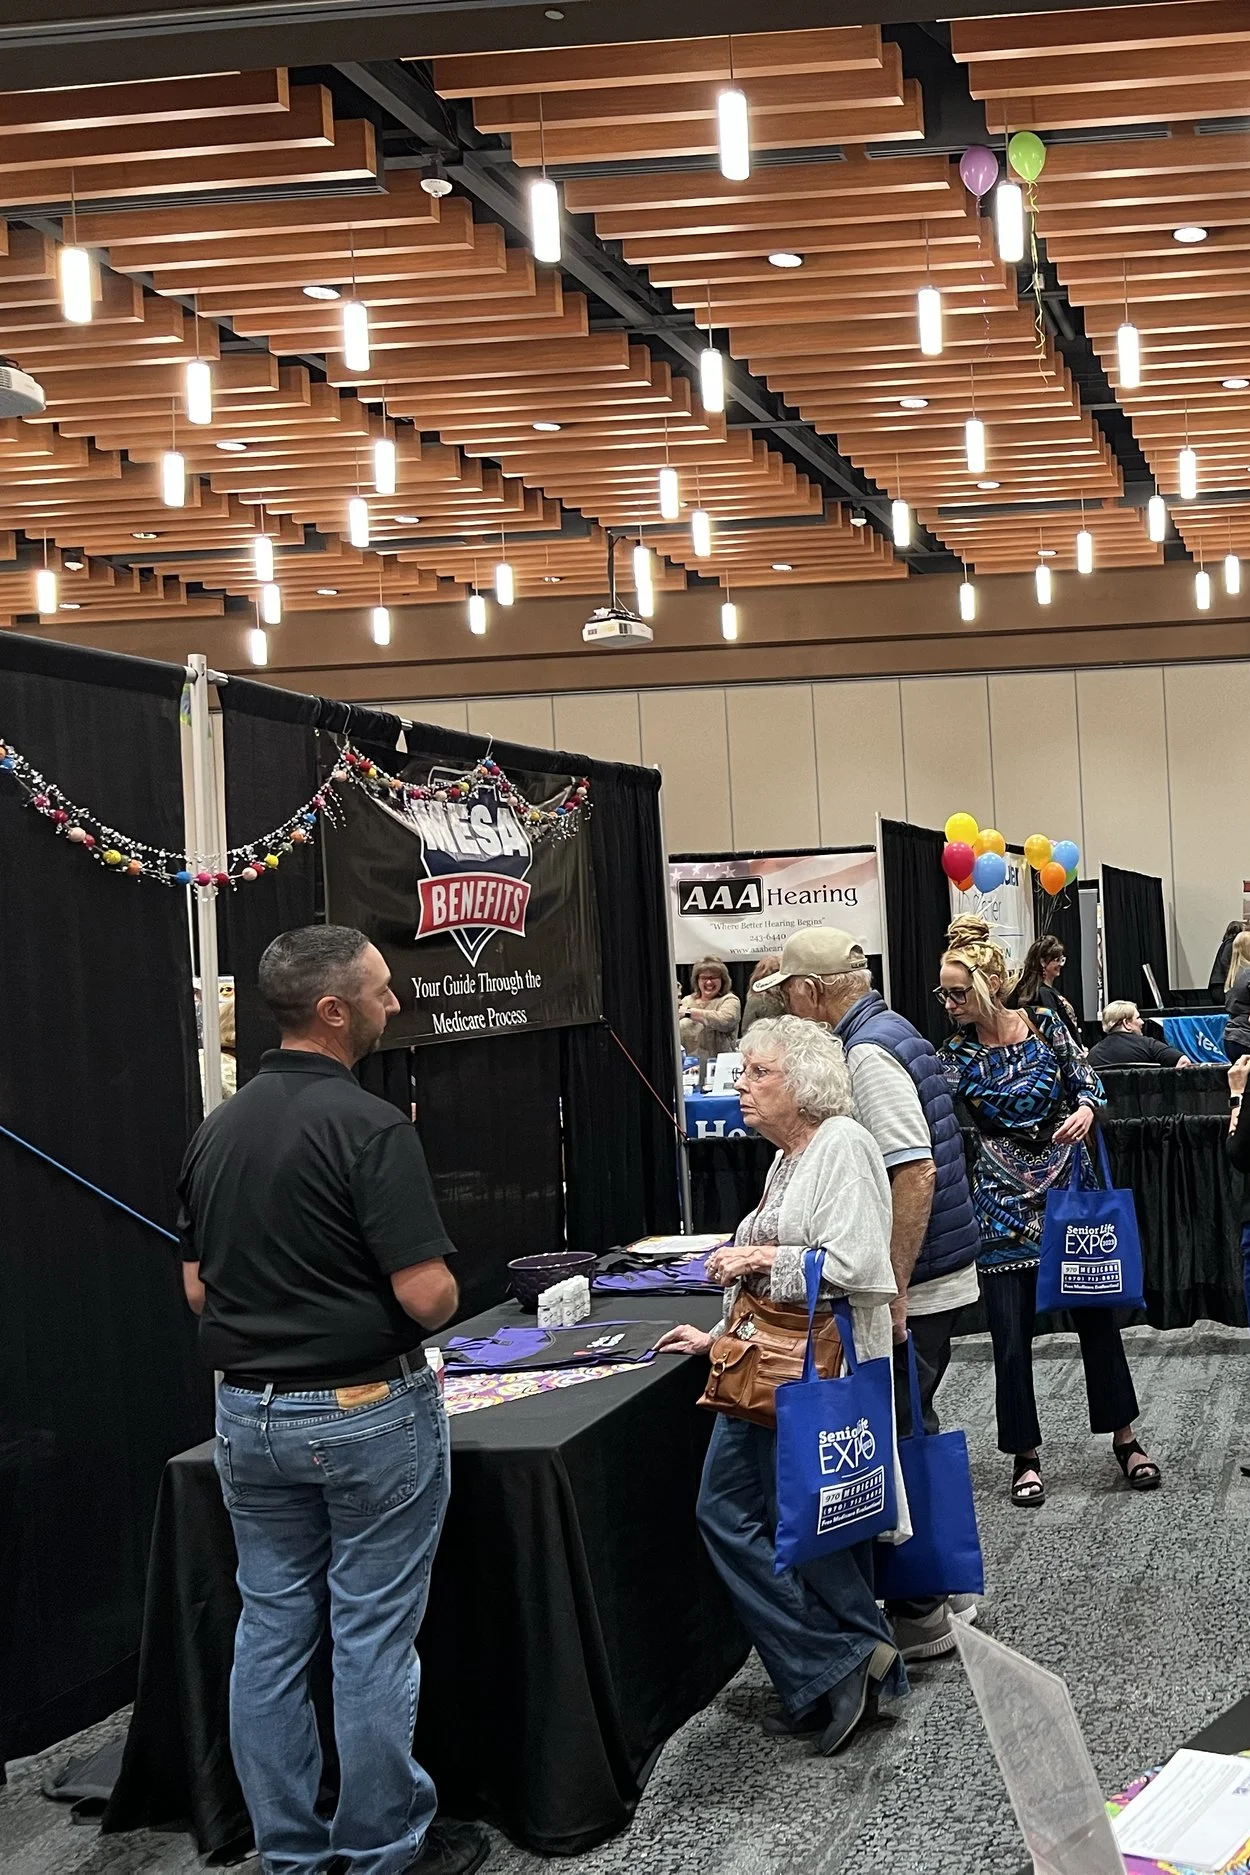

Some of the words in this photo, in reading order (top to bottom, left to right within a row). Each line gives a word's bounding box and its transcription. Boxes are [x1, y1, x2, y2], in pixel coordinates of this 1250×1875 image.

[410, 798, 529, 857] MESA
[431, 880, 524, 926] BENEFITS
[683, 884, 760, 910] AAA
[767, 885, 858, 907] Hearing
[764, 920, 795, 928] Hearing
[411, 977, 440, 998] Your
[443, 973, 475, 995] Guide
[478, 970, 524, 995] Through
[525, 969, 541, 989] the
[432, 1010, 486, 1034] Medicare
[487, 1008, 527, 1028] Process
[1067, 1225, 1099, 1235] Senior
[1099, 1223, 1115, 1236] Life
[1065, 1232, 1117, 1254] EXPO
[1080, 1265, 1118, 1274] MEDICARE
[819, 1430, 876, 1474] EXPO
[825, 1493, 840, 1503] 970
[844, 1475, 882, 1498] MEDICARE
[821, 1517, 832, 1527] Free
[823, 1503, 846, 1515] (970)
